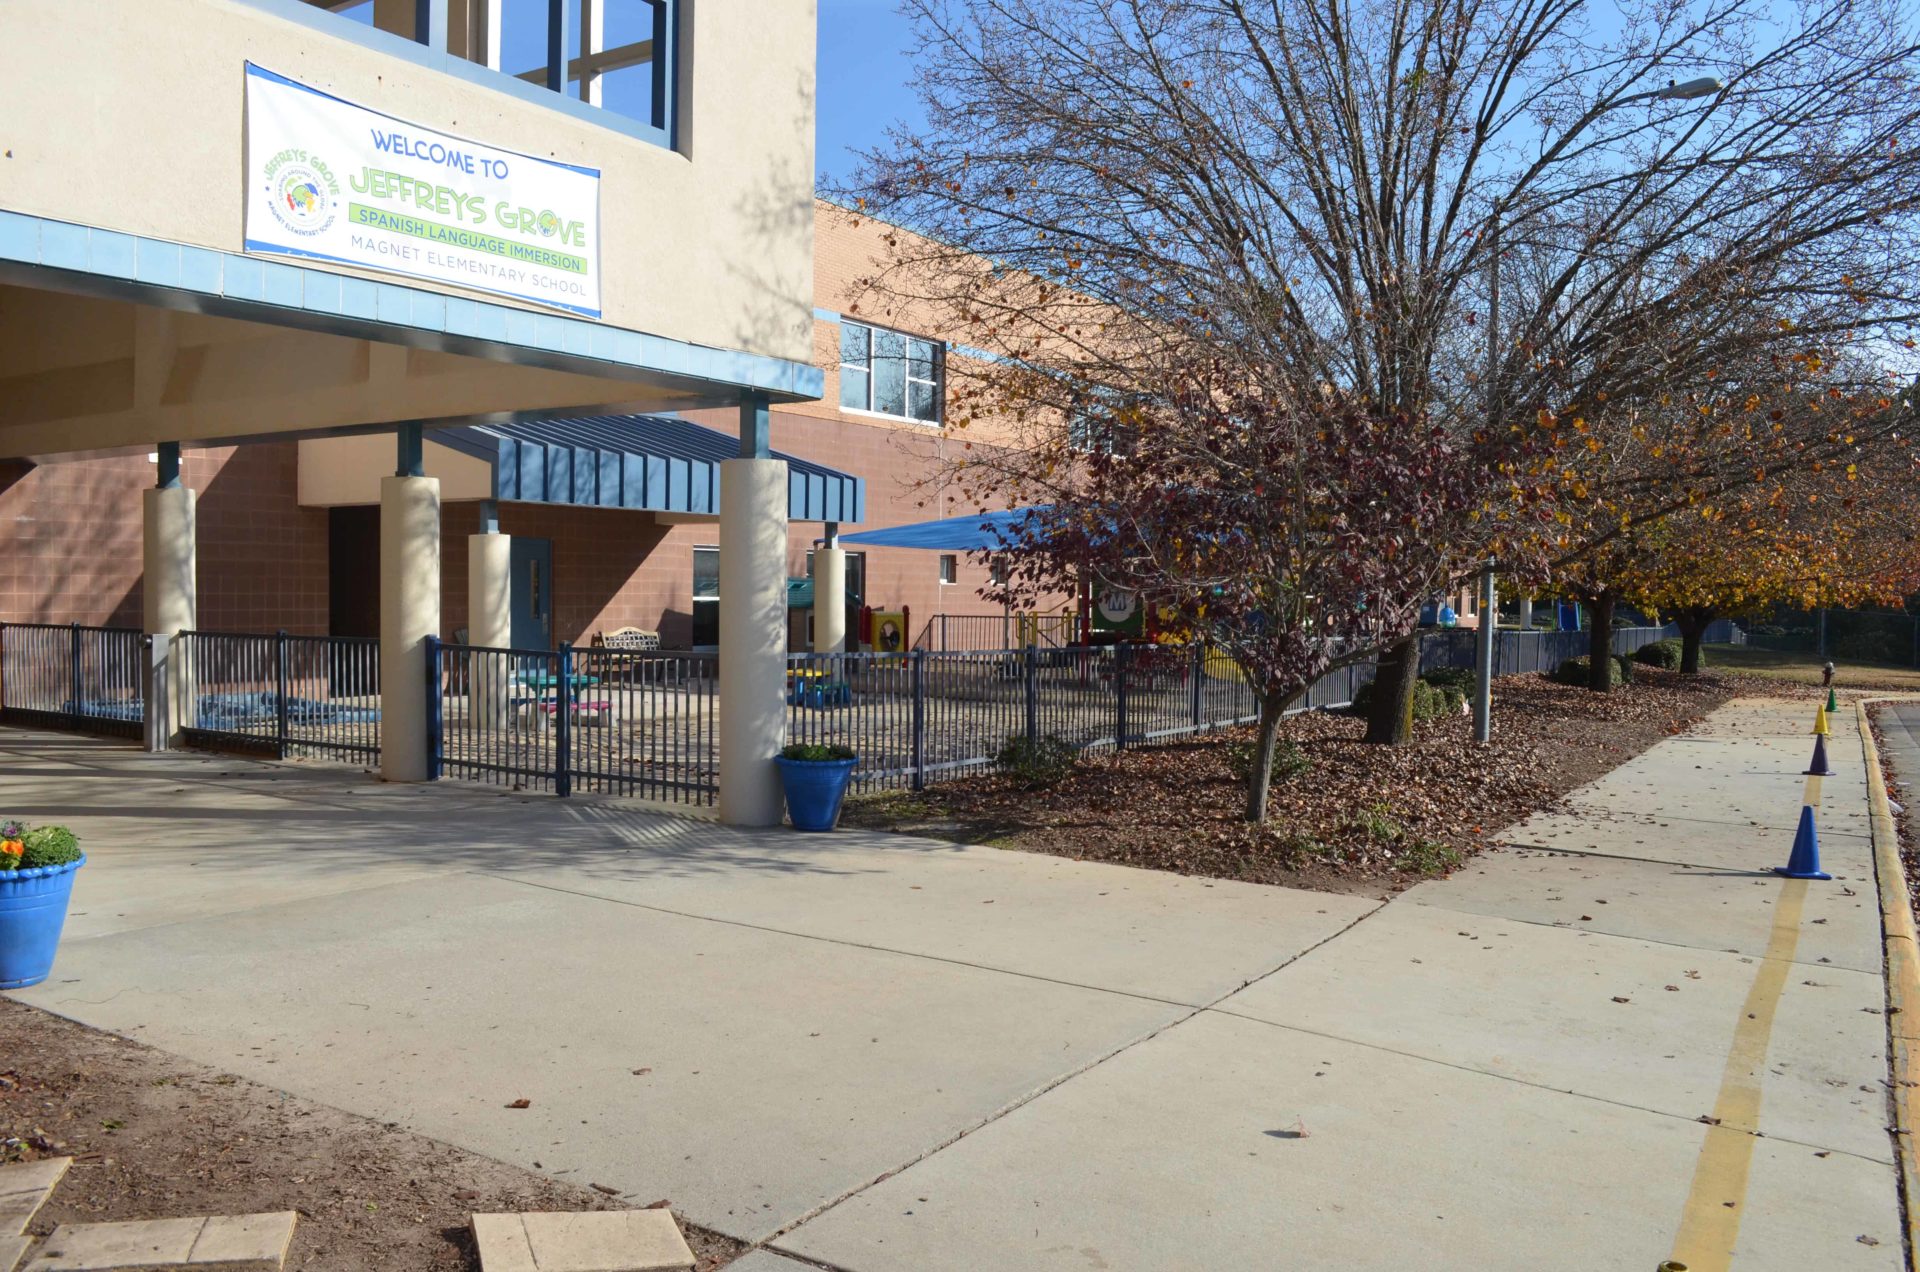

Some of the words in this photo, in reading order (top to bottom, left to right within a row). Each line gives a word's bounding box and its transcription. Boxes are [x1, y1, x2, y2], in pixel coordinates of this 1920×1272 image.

[264, 148, 307, 181] JEFFREYS
[310, 156, 340, 196] GROVE
[370, 128, 475, 174] WELCOME
[480, 159, 509, 179] TO
[349, 166, 487, 224] JEFFREYS
[494, 201, 586, 247] GROVE
[351, 235, 420, 259] MAGNET
[427, 251, 526, 283] ELEMENTARY
[532, 274, 587, 296] SCHOOL
[359, 209, 424, 236] SPANISH
[429, 225, 505, 254] LANGUAGE
[510, 244, 580, 271] IMMERSION
